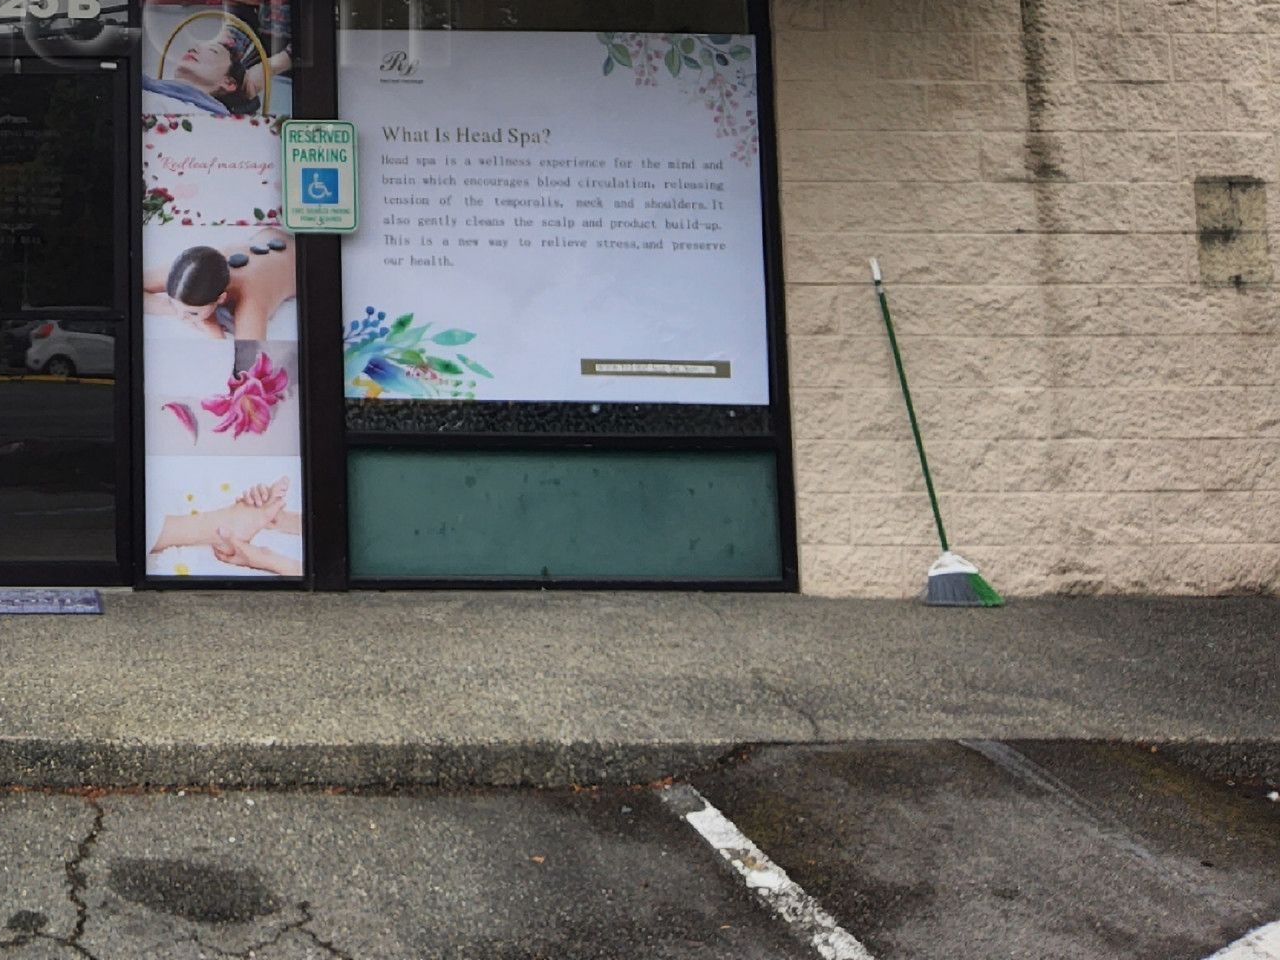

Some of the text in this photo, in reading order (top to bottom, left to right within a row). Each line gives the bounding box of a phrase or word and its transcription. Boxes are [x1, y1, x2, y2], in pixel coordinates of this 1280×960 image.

[289, 130, 350, 144] RESERVED
[382, 126, 551, 148] What Is Head Spa?
[293, 148, 347, 162] PARKING
[218, 160, 273, 175] massage
[445, 155, 456, 166] is
[478, 156, 531, 167] wellness
[539, 157, 606, 169] experience
[614, 157, 633, 168] for
[641, 158, 660, 169] the
[668, 159, 695, 170] mind
[703, 160, 724, 171] and
[382, 175, 415, 186] brain
[423, 175, 456, 186] which
[537, 176, 570, 187] blood
[384, 195, 430, 206] tension
[439, 195, 452, 206] of
[464, 195, 484, 206] the
[576, 197, 603, 209] neck
[614, 198, 635, 209] and
[383, 214, 410, 225] also
[417, 215, 457, 228] gently
[514, 216, 533, 227] the
[542, 217, 575, 229] scalp
[582, 218, 602, 228] and
[610, 218, 657, 230] product
[520, 237, 531, 247] to
[541, 237, 587, 248] relieve
[672, 240, 726, 252] preserve
[384, 257, 404, 266] our
